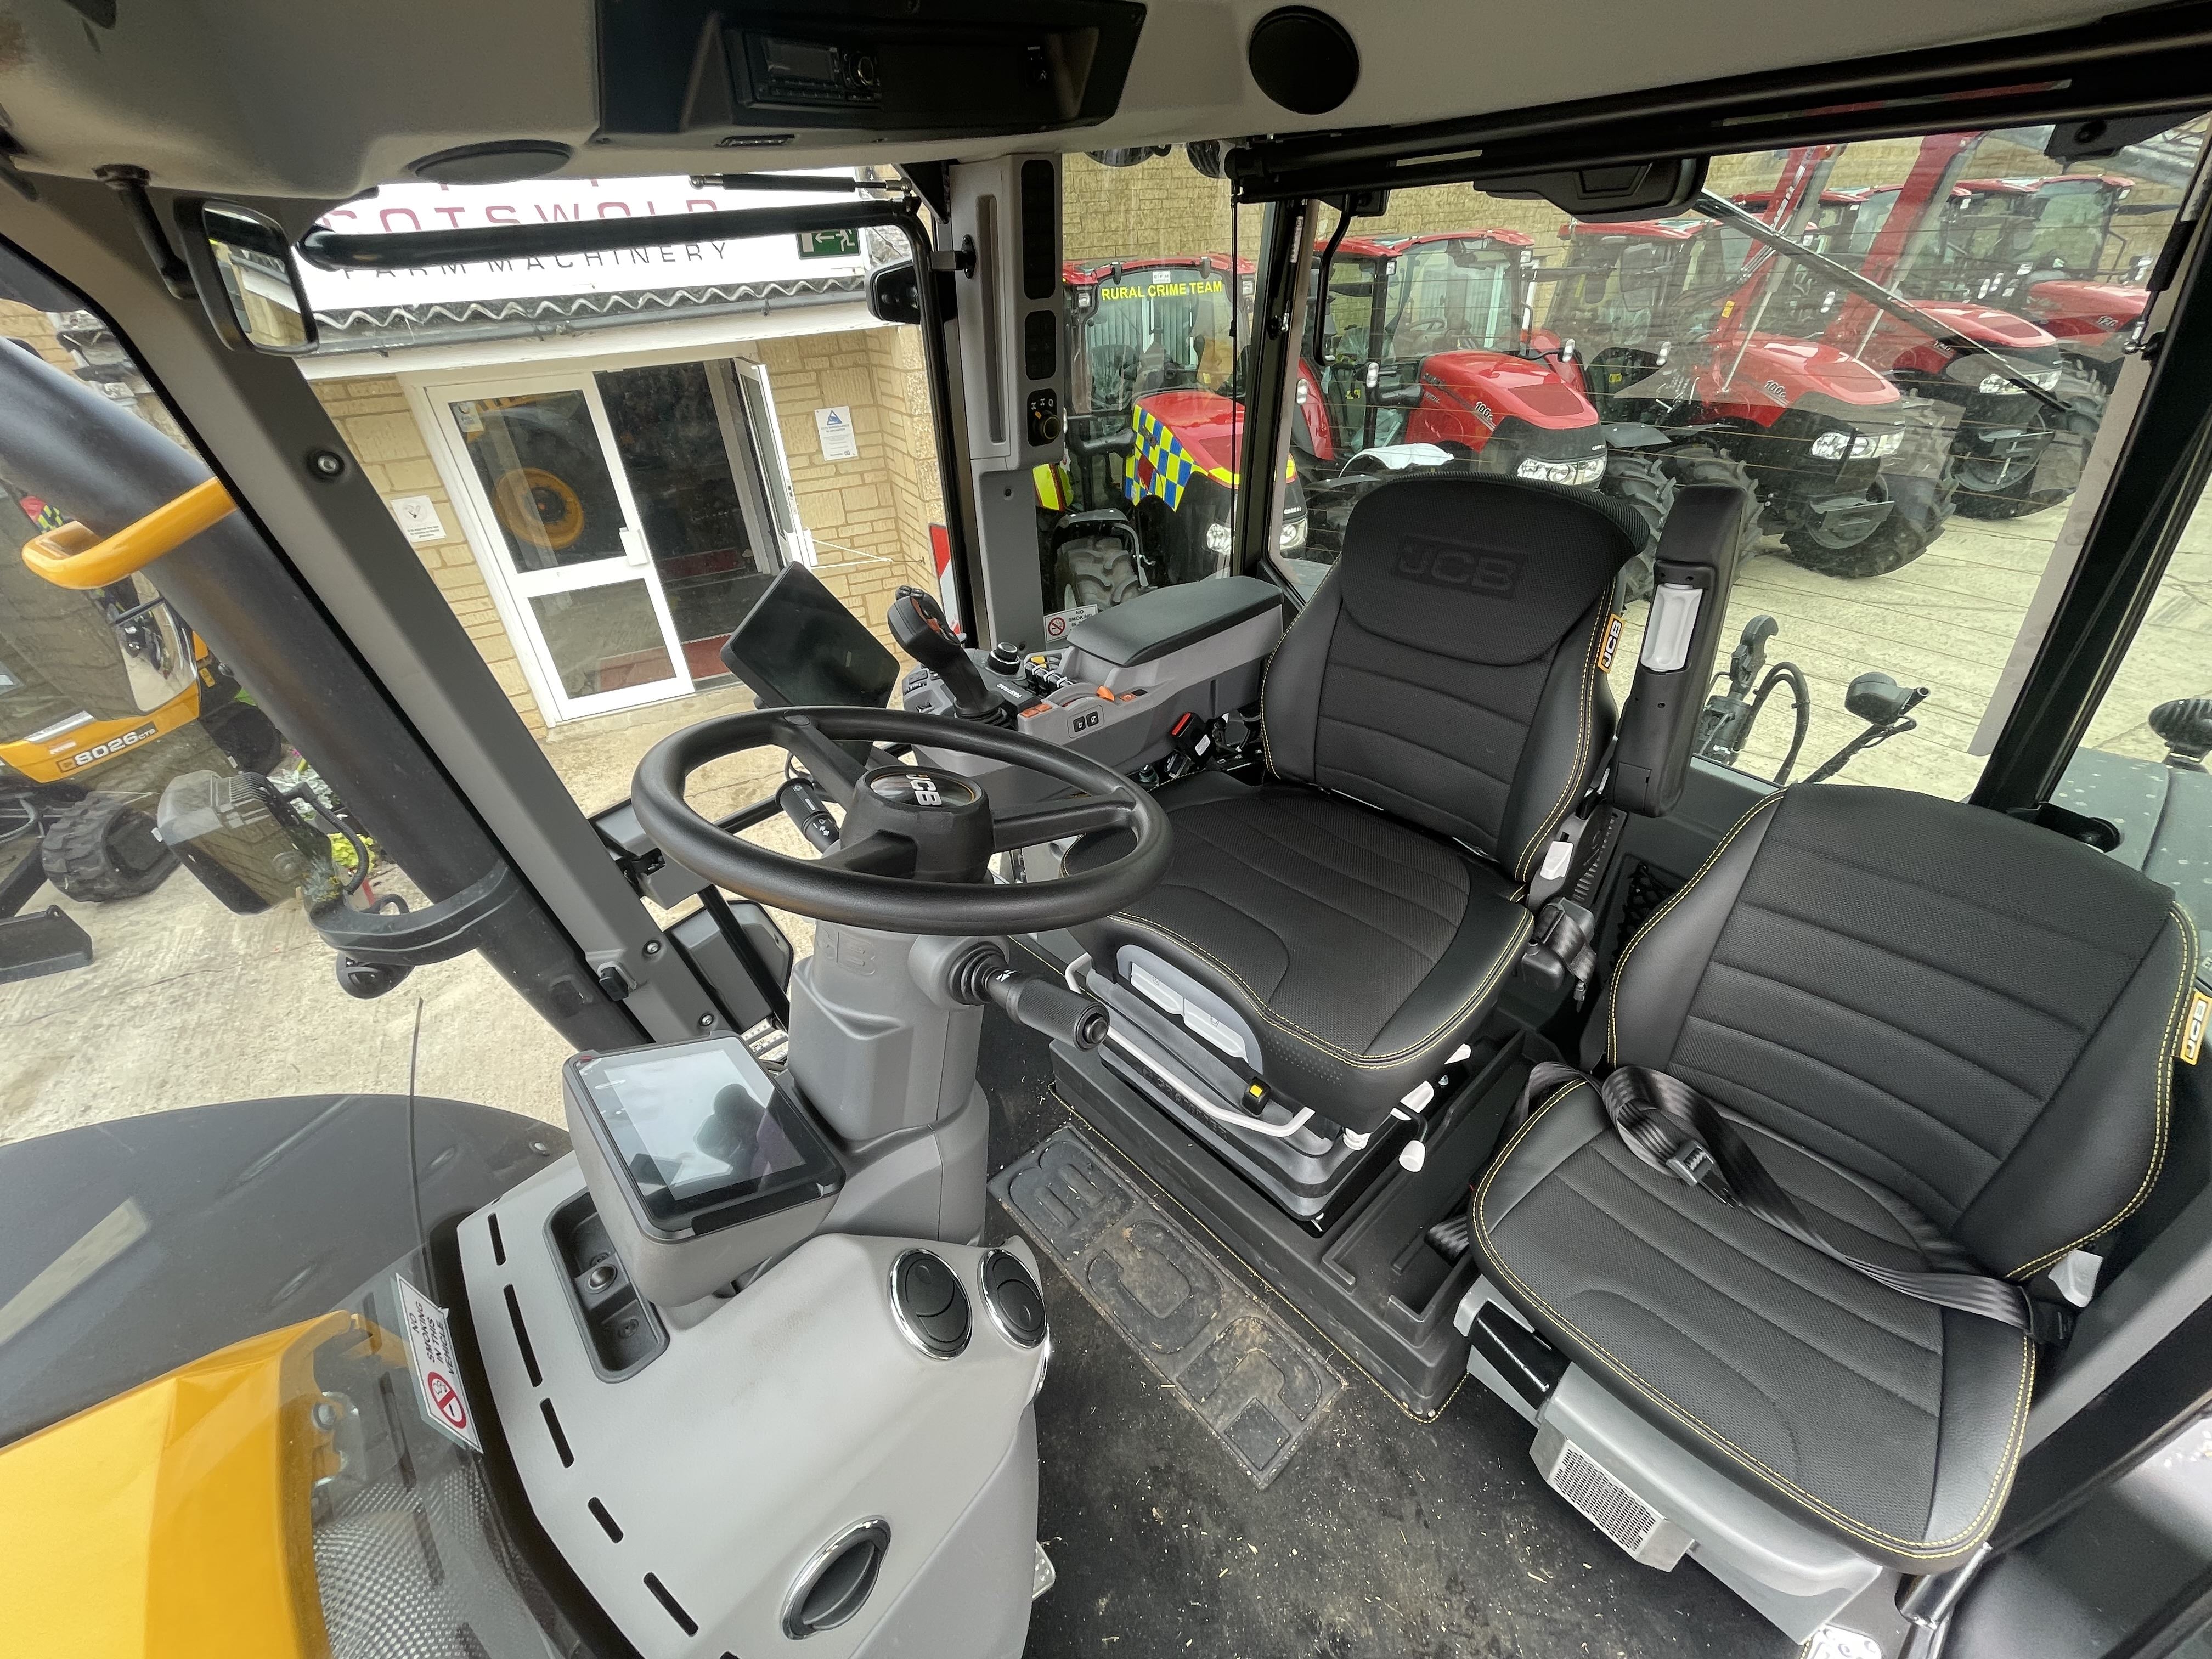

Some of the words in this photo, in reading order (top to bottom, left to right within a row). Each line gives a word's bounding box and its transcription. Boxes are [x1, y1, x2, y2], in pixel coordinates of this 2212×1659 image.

[487, 242, 725, 273] MACHINERY
[1102, 286, 1145, 301] RURAL
[1148, 283, 1187, 297] CRIME
[1189, 280, 1223, 294] TEAM
[1400, 546, 1516, 591] JCB
[1604, 620, 1622, 667] JCB
[906, 774, 943, 806] JCB
[2187, 999, 2208, 1059] JCB
[1008, 1141, 1323, 1465] JCB
[409, 1312, 420, 1334] NO
[415, 1300, 435, 1363] SMOKING
[427, 1317, 440, 1350] THIS
[436, 1351, 444, 1364] IN
[437, 1319, 454, 1375] VEHICLE
